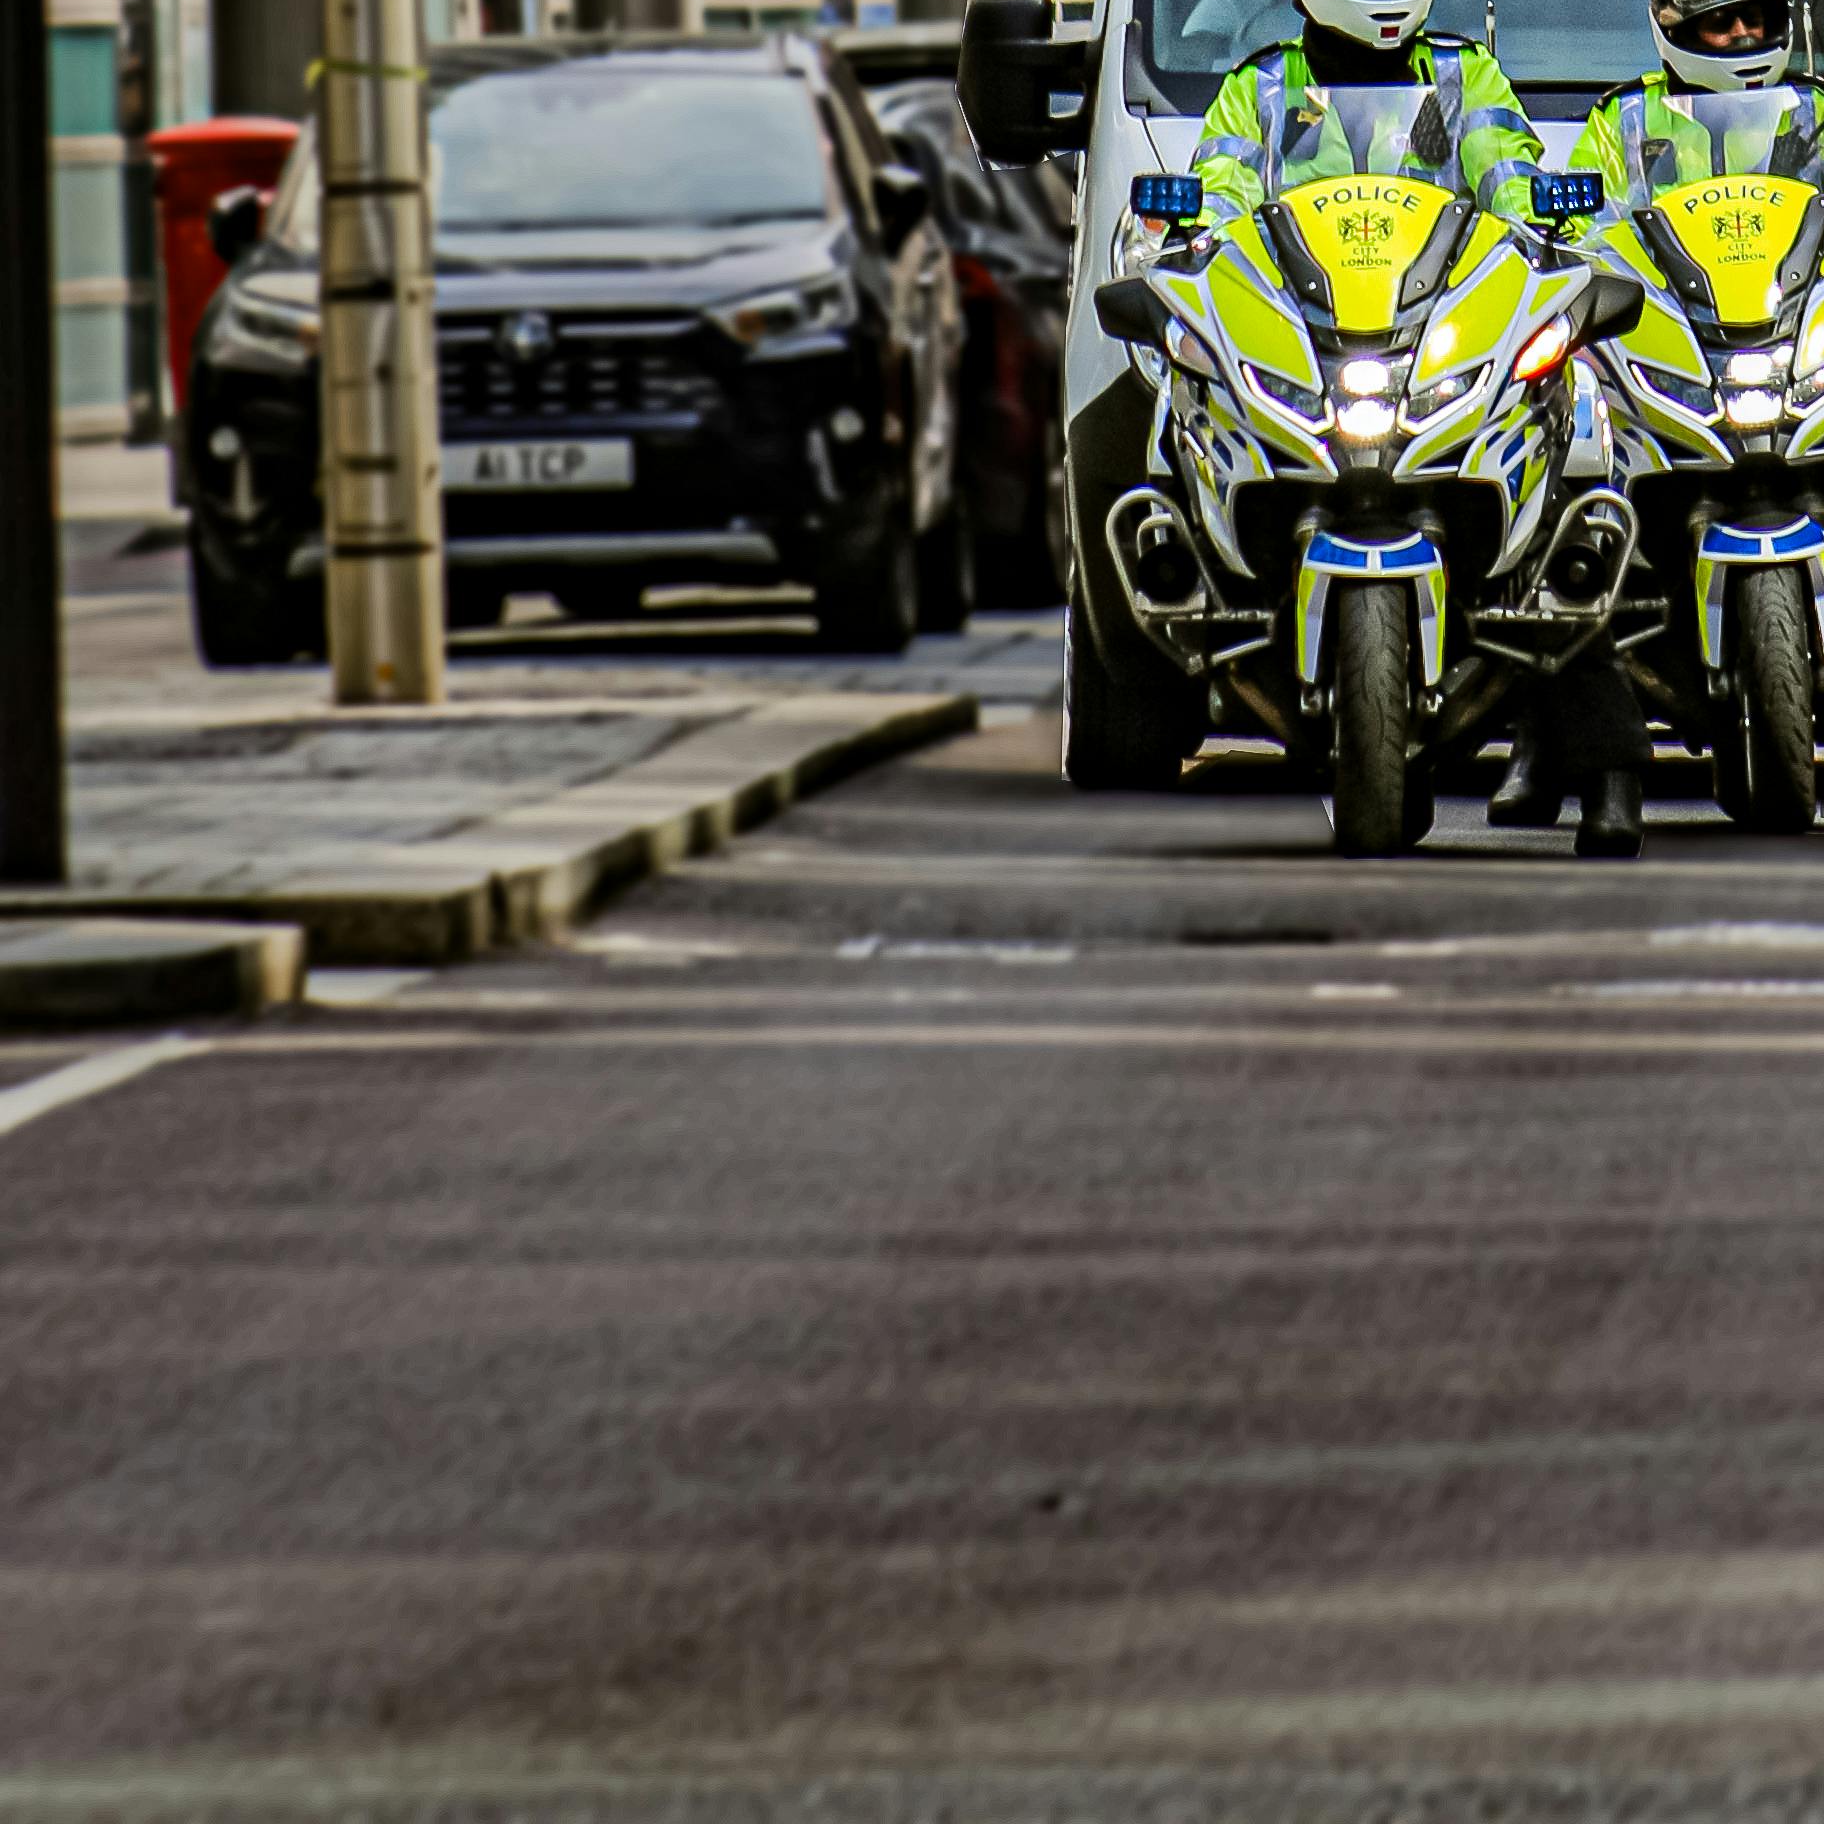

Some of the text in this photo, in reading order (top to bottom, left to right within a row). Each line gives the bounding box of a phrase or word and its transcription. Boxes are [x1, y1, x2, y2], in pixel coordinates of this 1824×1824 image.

[1313, 185, 1422, 214] POLICE
[1683, 184, 1787, 214] POLICE
[1352, 247, 1380, 256] CITY
[1727, 242, 1753, 252] CITY
[1340, 258, 1393, 268] LONDON
[1717, 253, 1767, 264] LONDON
